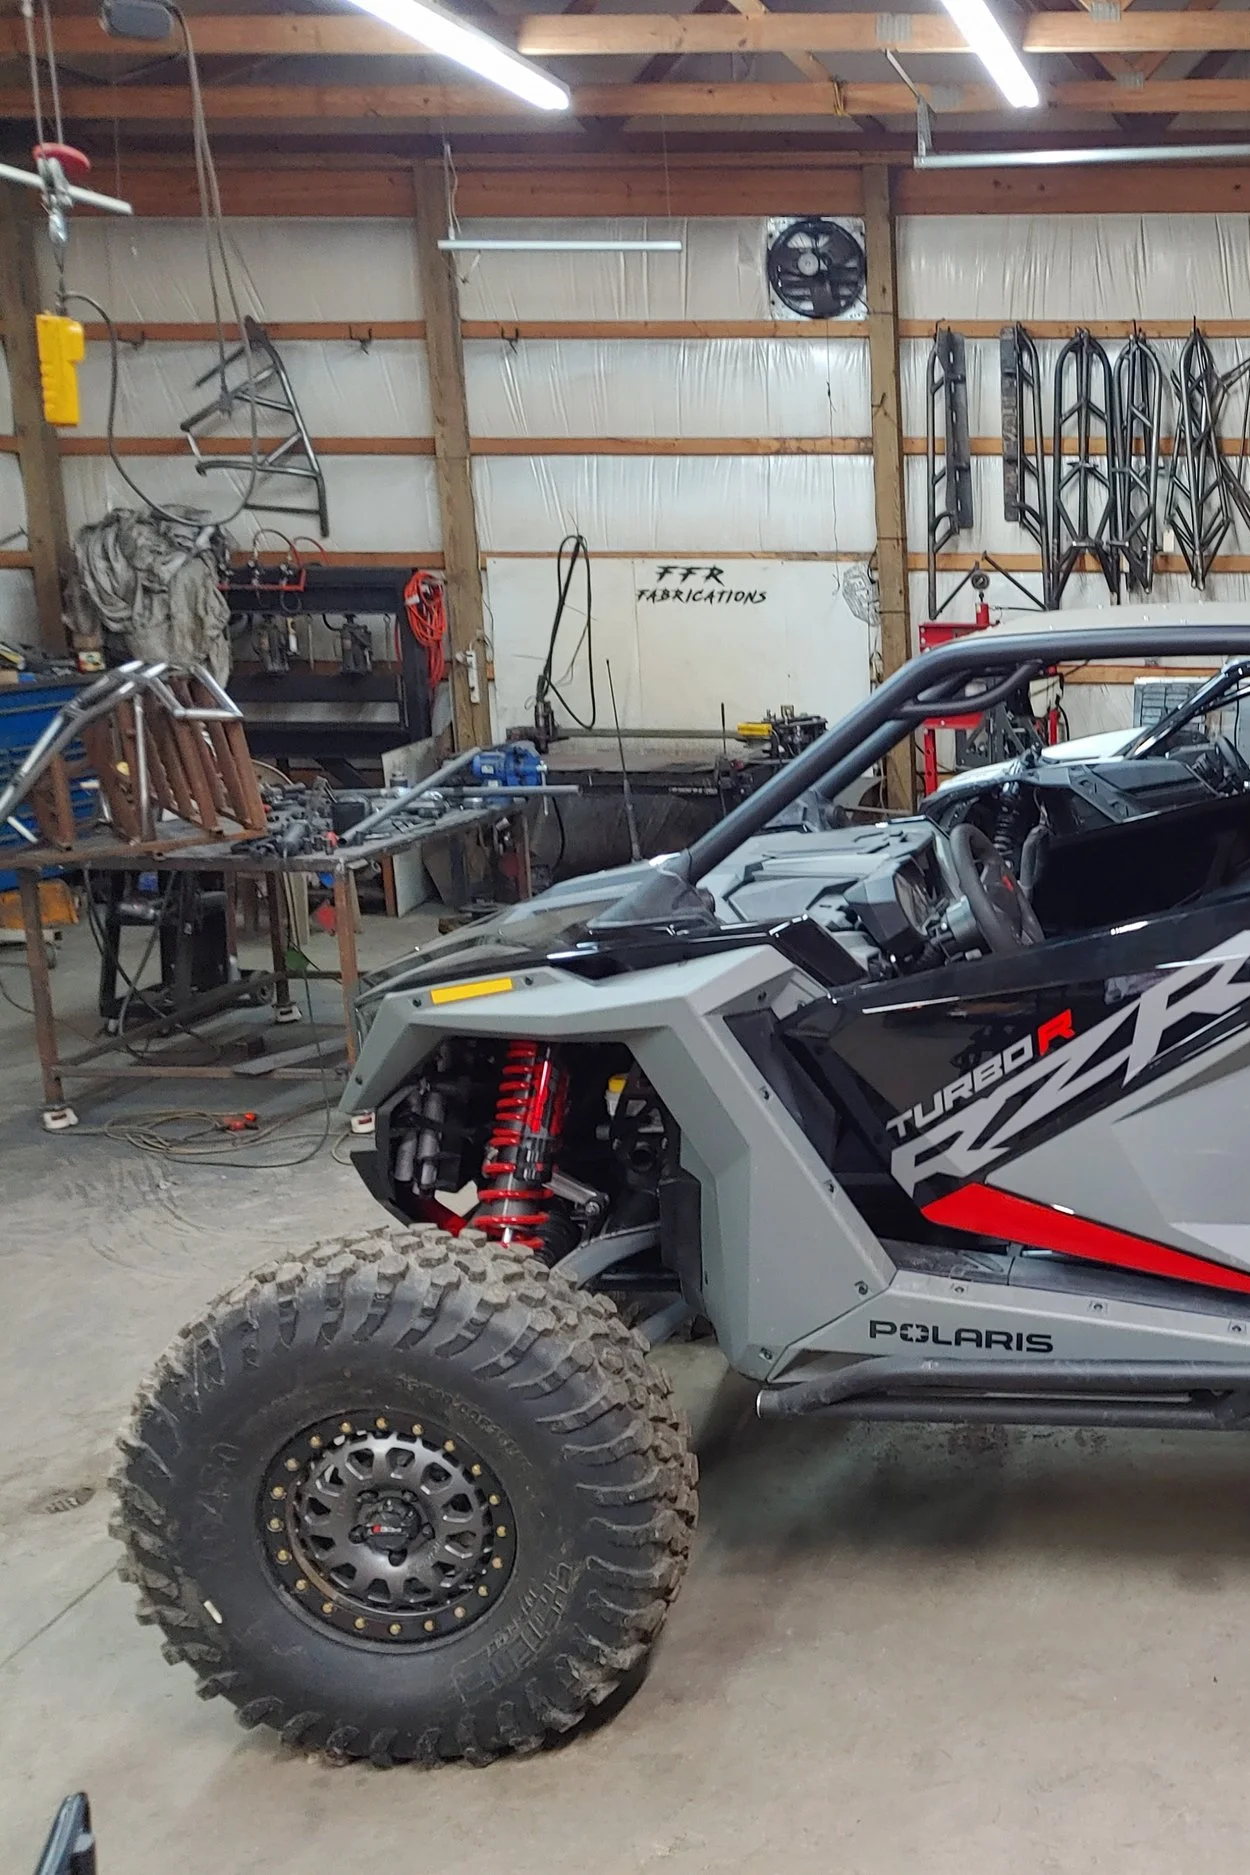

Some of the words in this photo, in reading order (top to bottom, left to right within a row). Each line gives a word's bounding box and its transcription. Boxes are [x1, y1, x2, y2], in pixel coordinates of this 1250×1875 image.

[655, 564, 726, 587] FFR
[635, 588, 768, 605] FABRICATIONS
[869, 1320, 1054, 1353] POLARIS
